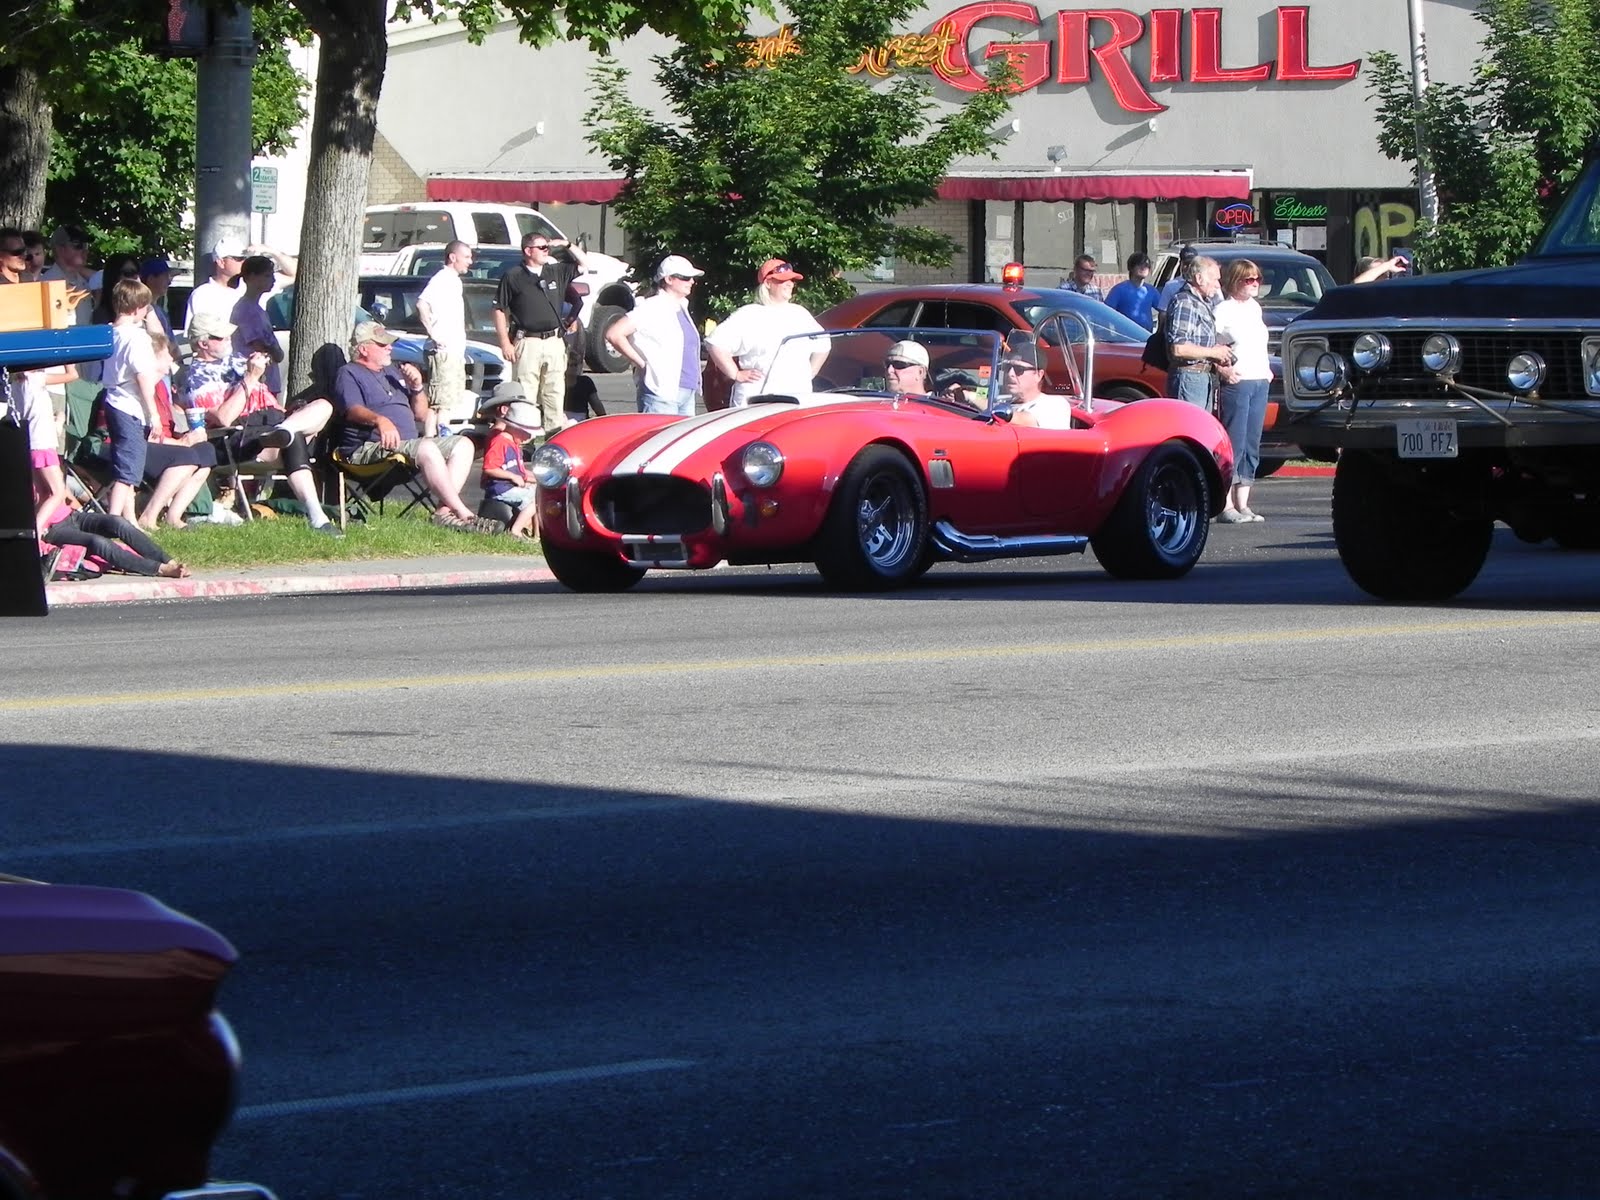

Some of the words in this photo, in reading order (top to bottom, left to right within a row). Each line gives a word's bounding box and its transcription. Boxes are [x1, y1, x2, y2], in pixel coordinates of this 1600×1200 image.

[845, 21, 968, 78] reet
[930, 1, 1362, 112] GRILL
[253, 167, 260, 181] 2
[1216, 209, 1253, 225] OPEN
[1273, 197, 1328, 221] Espresso
[1401, 432, 1424, 452] 700
[1430, 432, 1455, 452] PFZ
